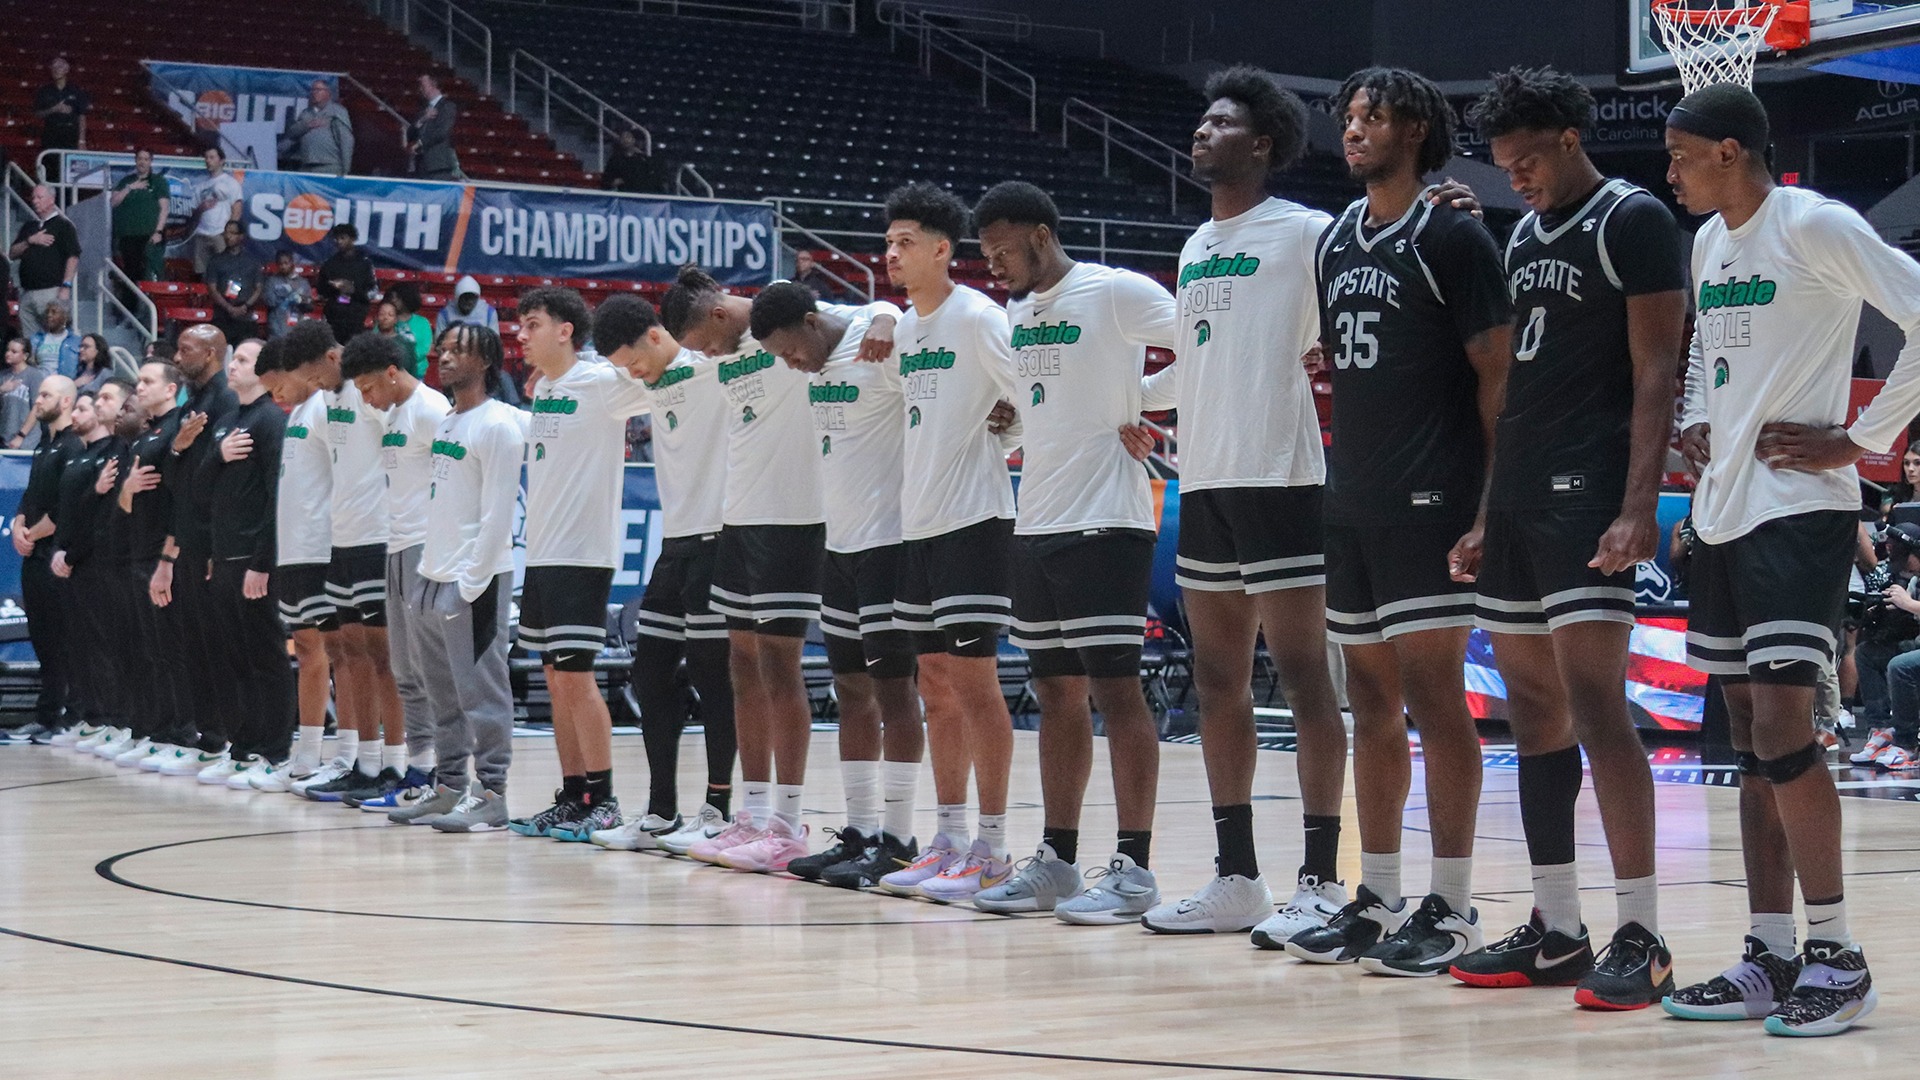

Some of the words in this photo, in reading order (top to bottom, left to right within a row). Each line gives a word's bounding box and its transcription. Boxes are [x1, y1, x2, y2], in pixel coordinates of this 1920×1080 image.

[1597, 127, 1658, 141] Carolina
[284, 208, 334, 230] BIG
[481, 206, 767, 270] CHAMPIONSHIPS
[1184, 280, 1232, 317] SOLE
[1328, 266, 1400, 309] UPSTATE
[1334, 311, 1381, 370] 35
[1516, 306, 1547, 361] 0
[1705, 312, 1751, 351] SOLE
[1018, 348, 1060, 377] SOLE
